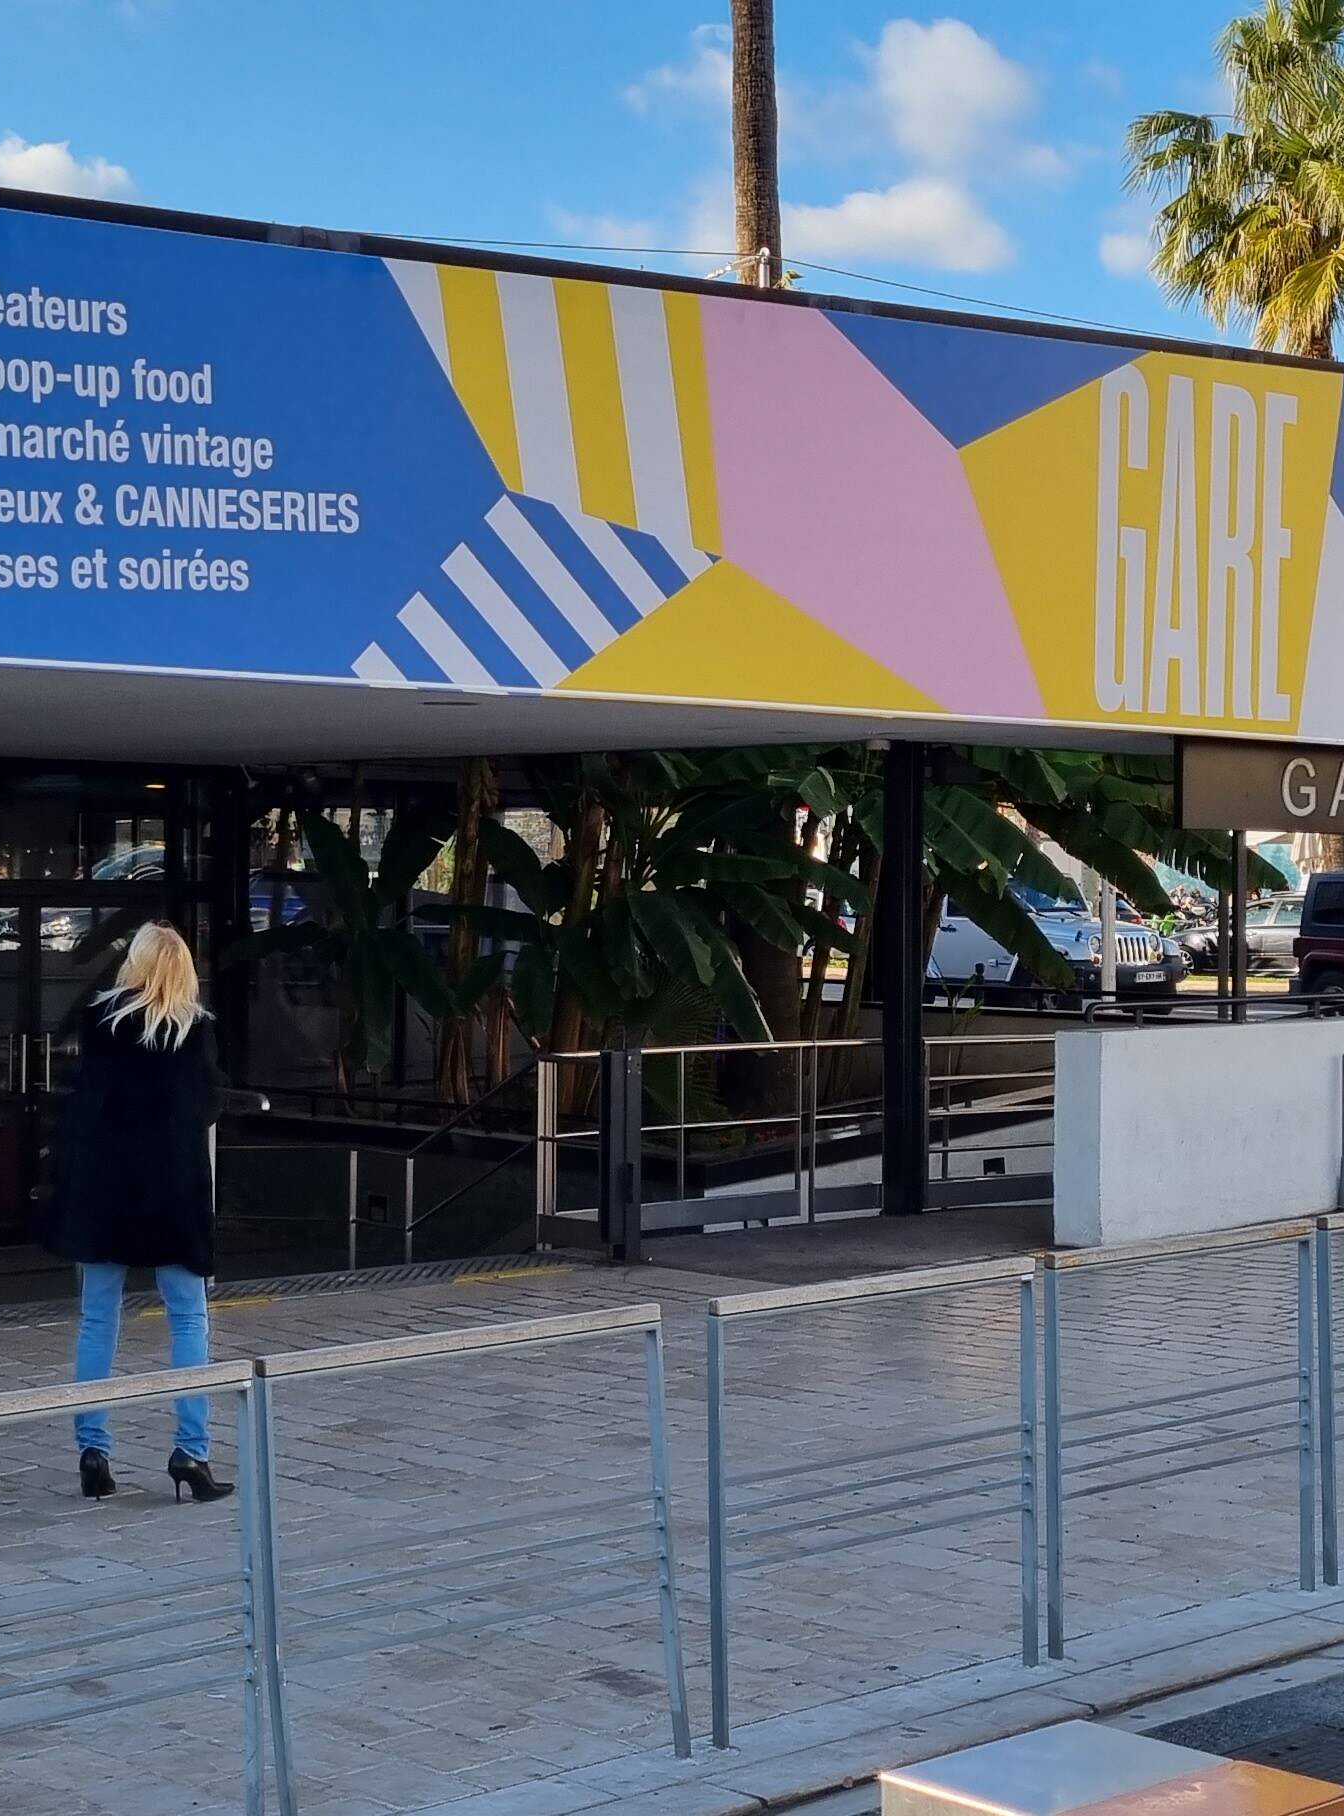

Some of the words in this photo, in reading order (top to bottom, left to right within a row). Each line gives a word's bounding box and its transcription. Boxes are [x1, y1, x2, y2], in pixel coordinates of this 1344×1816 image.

[131, 359, 213, 405] food
[140, 424, 274, 478] vintage
[74, 483, 105, 526] &
[115, 484, 360, 534] CANNESERIES
[1093, 361, 1298, 722] GARE
[70, 549, 109, 590] et
[118, 547, 250, 592] soirées
